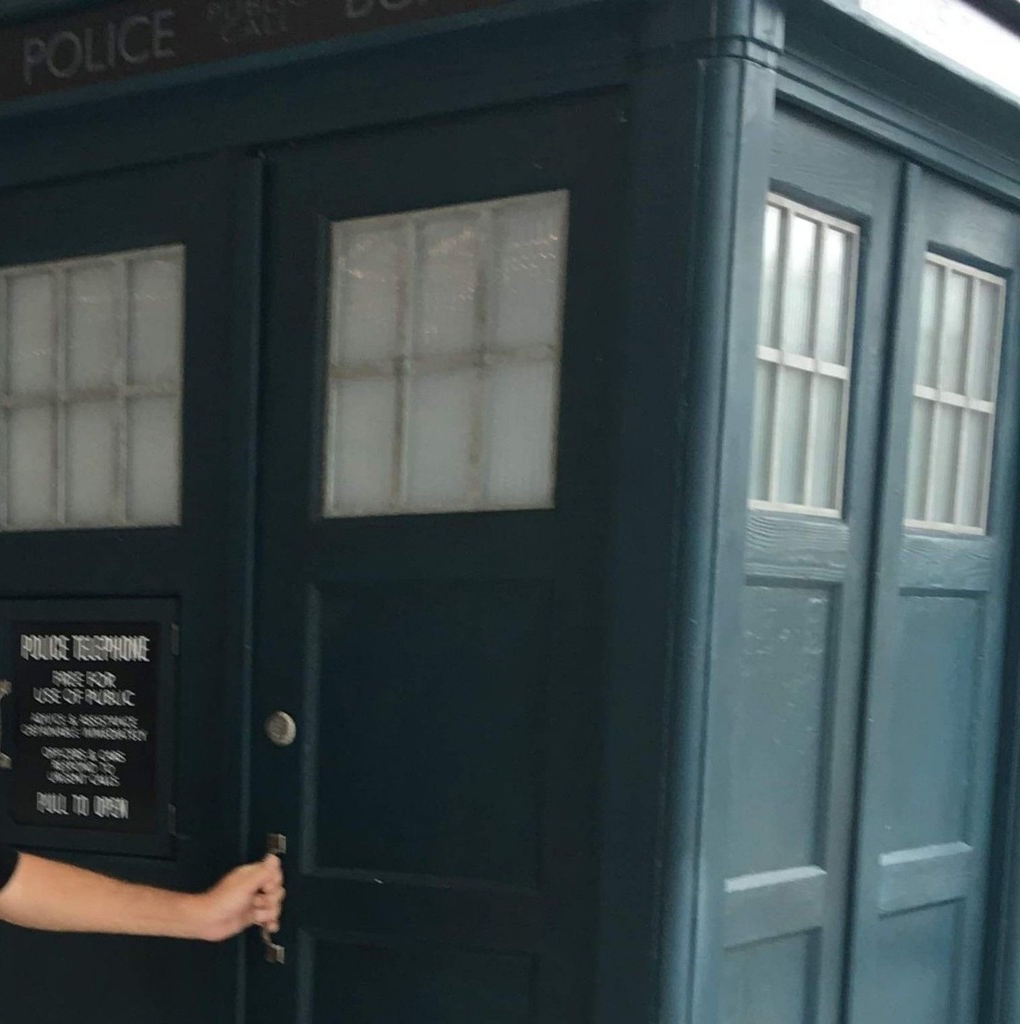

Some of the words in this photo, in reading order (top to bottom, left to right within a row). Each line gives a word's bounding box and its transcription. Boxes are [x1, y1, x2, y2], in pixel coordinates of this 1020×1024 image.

[22, 10, 176, 85] POLICE
[20, 634, 70, 661] POLICE
[72, 635, 150, 662] TELEPHONE
[52, 670, 84, 687] FREE
[86, 671, 117, 688] FOR
[33, 687, 62, 704] USE
[62, 688, 84, 705] OF
[84, 688, 135, 706] PUBLIC
[37, 792, 69, 815] PULL
[72, 794, 89, 816] TO
[93, 795, 129, 819] OPEN
